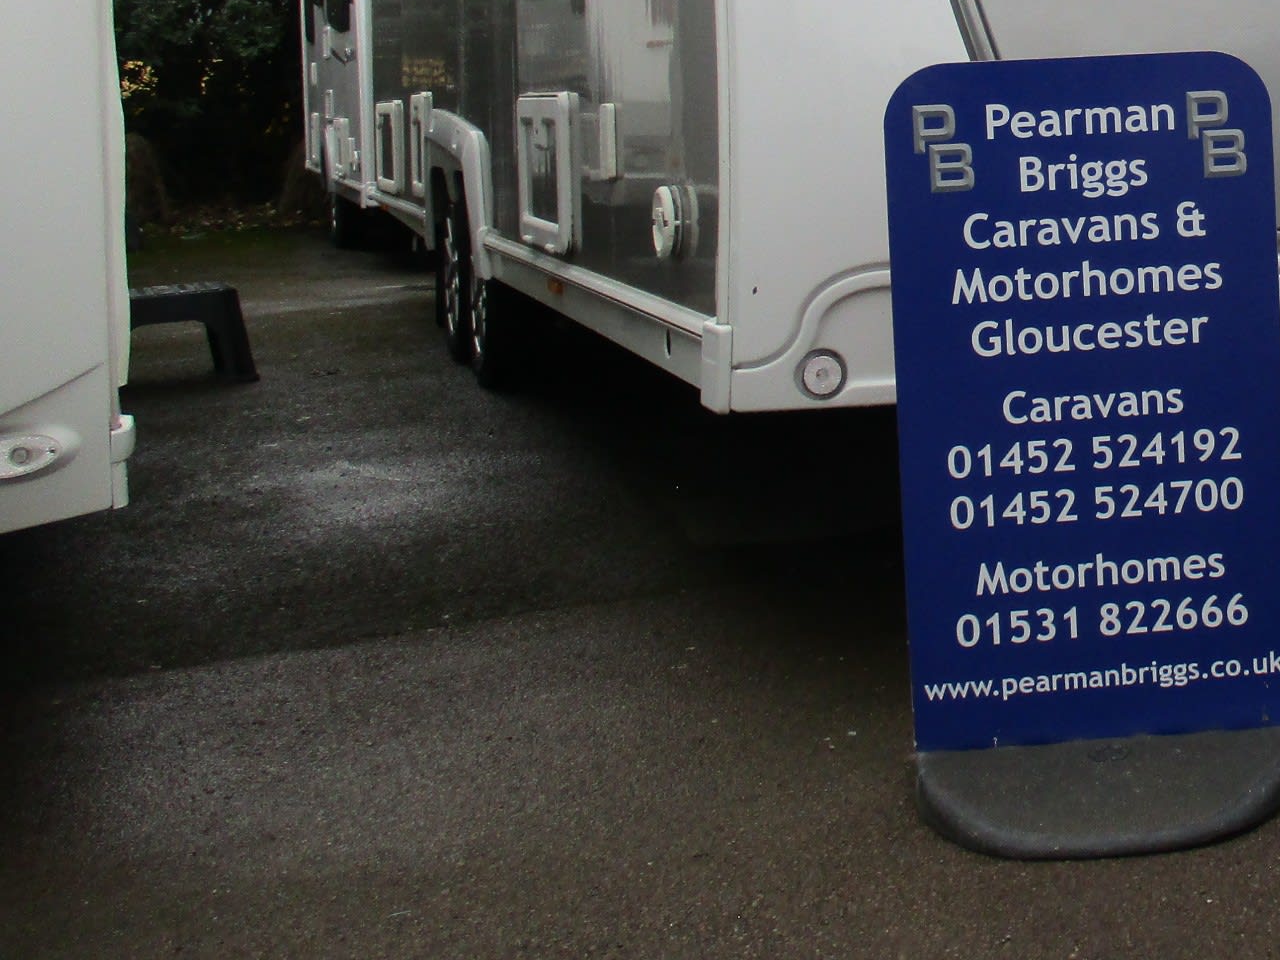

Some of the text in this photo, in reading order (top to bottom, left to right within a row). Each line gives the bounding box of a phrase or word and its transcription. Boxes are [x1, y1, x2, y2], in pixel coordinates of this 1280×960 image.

[985, 102, 1175, 140] Pearman
[1019, 153, 1149, 198] Briggs
[962, 201, 1207, 250] Caravans &
[951, 260, 1223, 305] Motorhomes
[971, 312, 1209, 358] Gloucester
[1002, 387, 1184, 424] Caravans
[947, 426, 1243, 480] 01452 524192
[949, 476, 1245, 530] 01452 524700
[975, 552, 1226, 597] Motorhomes
[956, 592, 1250, 649] 01531 822666
